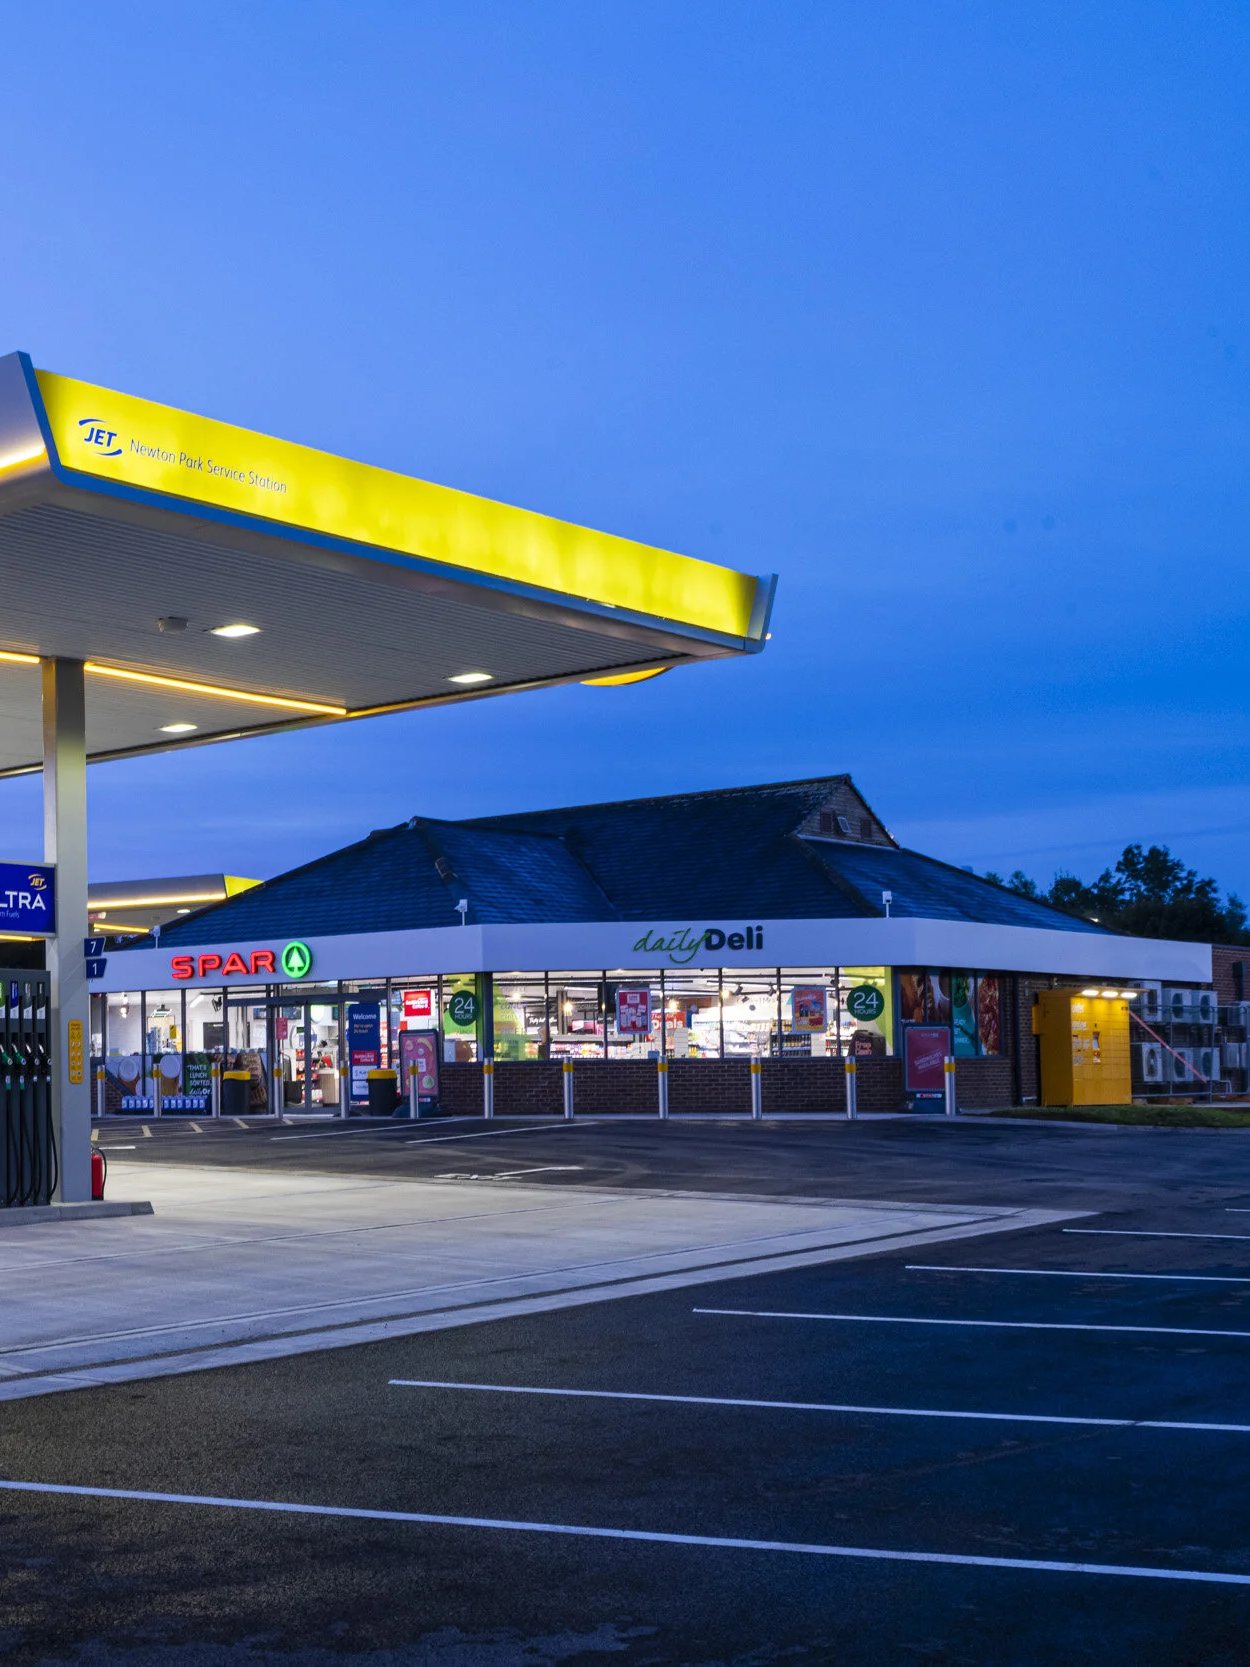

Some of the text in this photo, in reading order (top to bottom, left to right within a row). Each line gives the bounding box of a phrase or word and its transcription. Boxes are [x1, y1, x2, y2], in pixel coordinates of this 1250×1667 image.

[84, 427, 117, 448] JET
[130, 438, 287, 494] Newton Park Service Station
[30, 877, 45, 887] JET
[6, 910, 20, 919] Fuels
[90, 941, 97, 954] 7
[171, 950, 276, 980] SPAR
[454, 997, 475, 1014] 24
[853, 992, 879, 1009] 24
